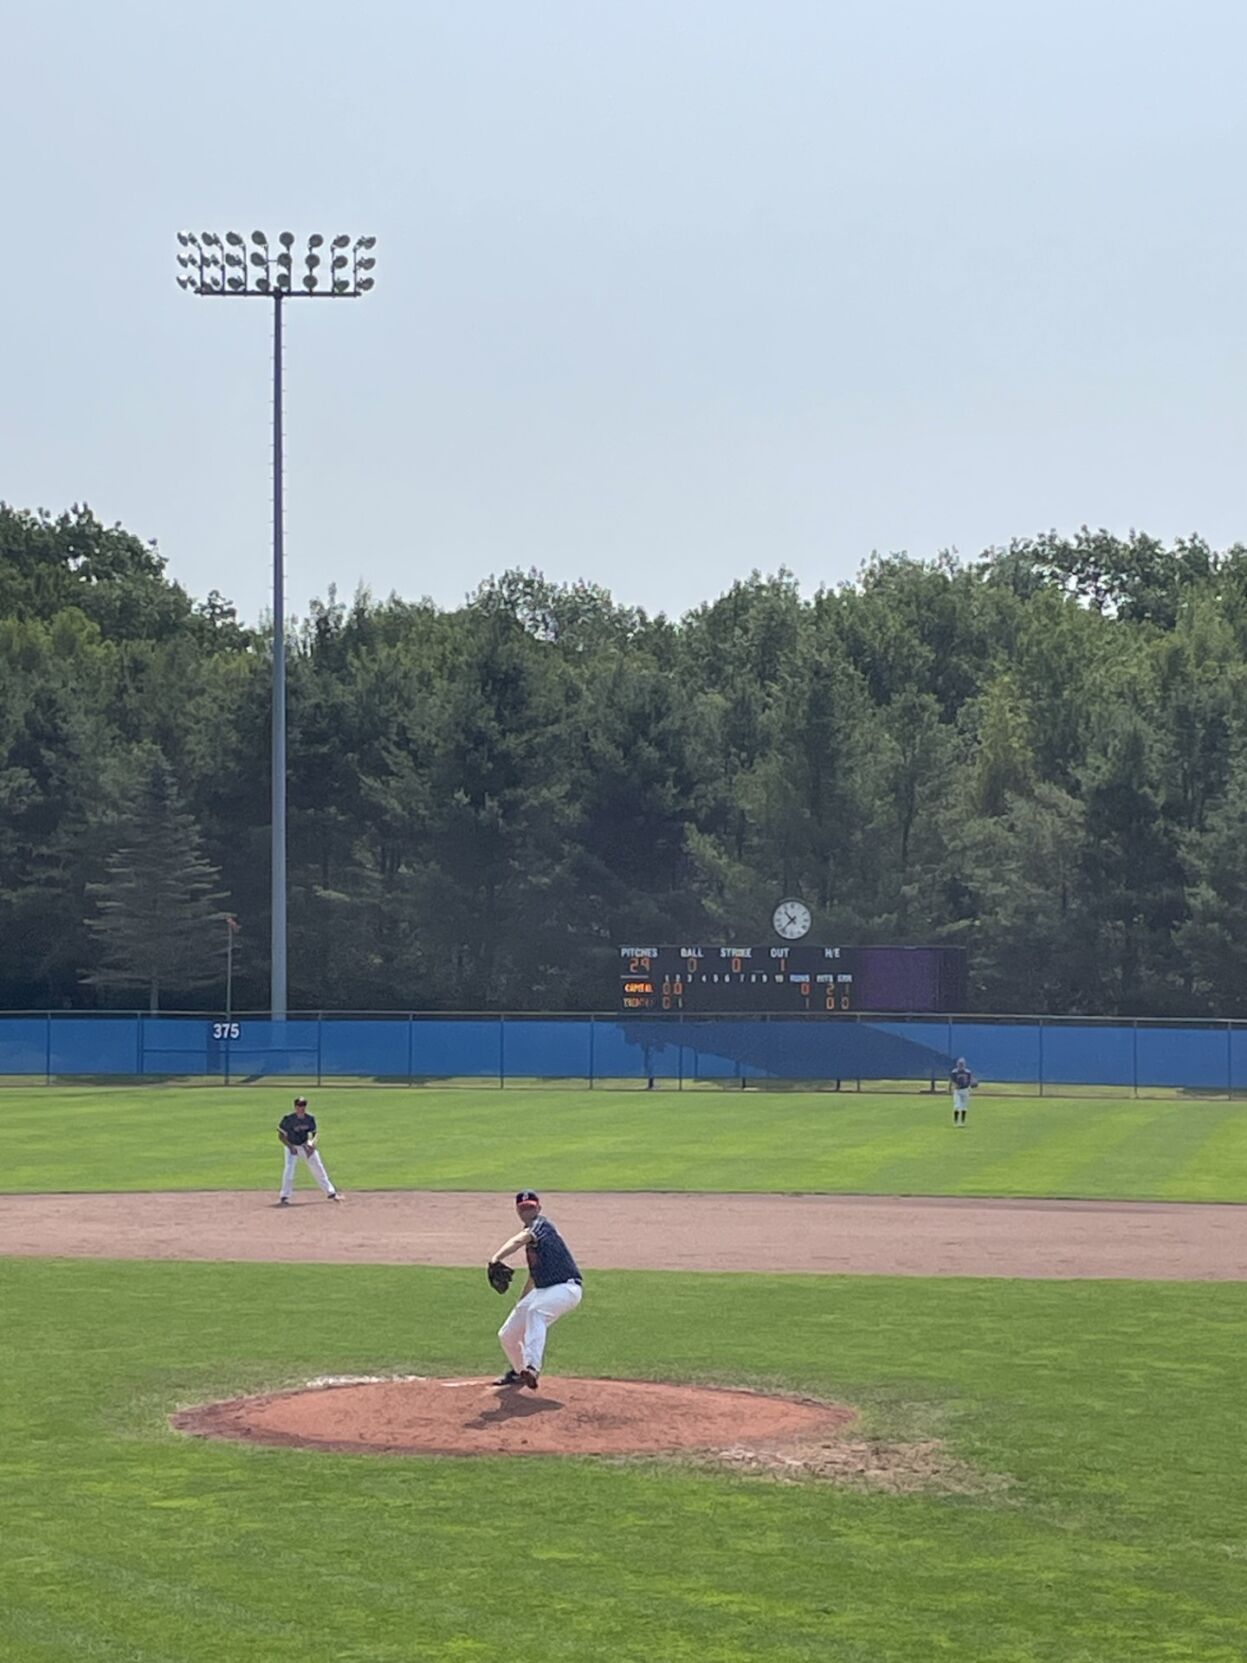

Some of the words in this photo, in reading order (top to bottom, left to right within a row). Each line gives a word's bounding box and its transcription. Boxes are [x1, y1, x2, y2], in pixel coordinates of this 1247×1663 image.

[621, 948, 658, 958] PITCHES
[680, 948, 704, 958] BALL
[720, 948, 753, 958] STRIKE
[770, 948, 790, 958] OUT
[629, 958, 651, 973] 29
[687, 958, 698, 973] 0
[732, 958, 742, 973] 0
[687, 974, 693, 983] 3
[701, 974, 707, 983] 4
[713, 974, 719, 983] 5
[724, 974, 730, 983] 6
[762, 974, 768, 983] 9
[663, 983, 671, 995] 0
[673, 983, 683, 995] 0
[800, 983, 810, 995] 0
[826, 996, 835, 1009] 0
[213, 1023, 240, 1039] 375
